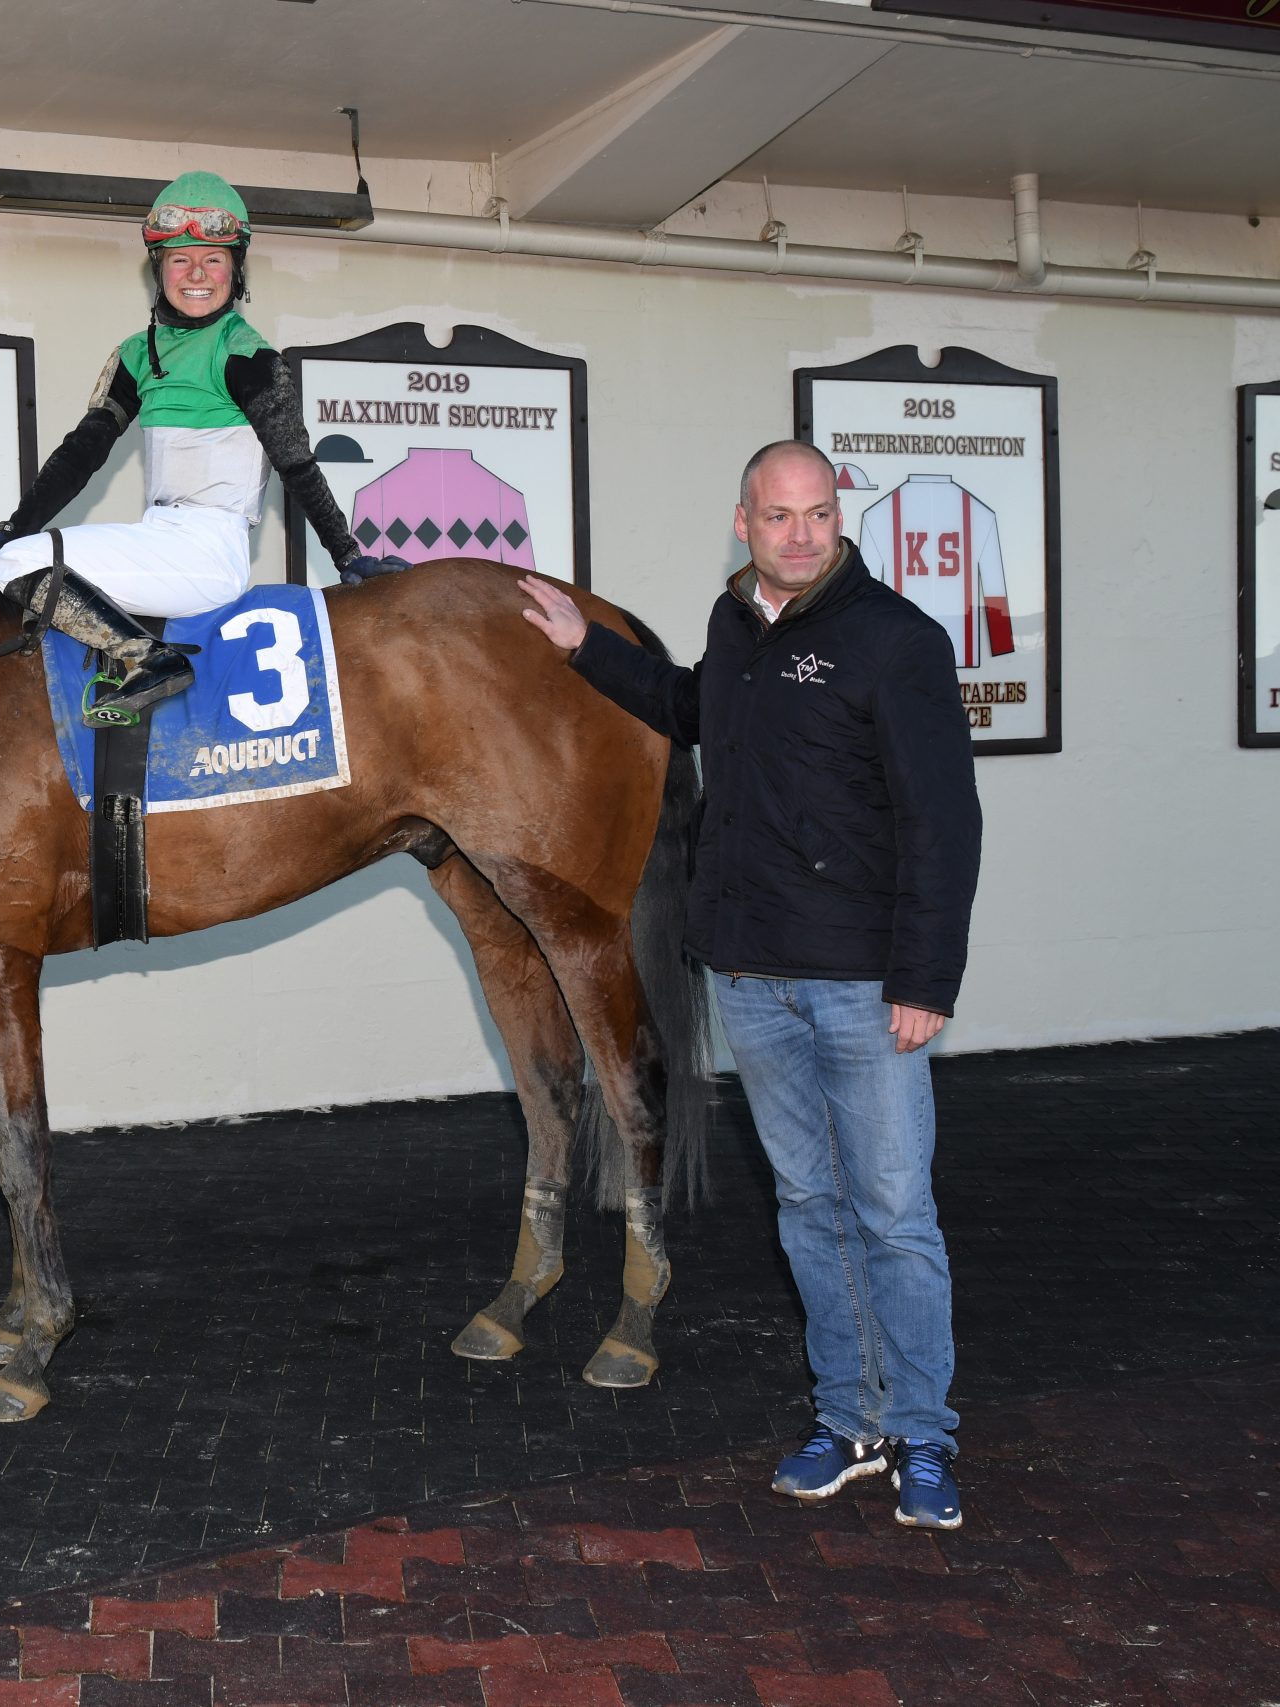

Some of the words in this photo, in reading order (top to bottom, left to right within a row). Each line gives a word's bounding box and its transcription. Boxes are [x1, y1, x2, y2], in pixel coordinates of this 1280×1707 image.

[407, 371, 470, 393] 2019
[317, 399, 440, 426] MAXIMUM
[448, 404, 558, 430] SECURITY
[903, 398, 956, 419] 2018
[831, 432, 1025, 457] PATTERNRECOGNITION
[220, 608, 310, 732] 3
[959, 681, 1027, 705] TABLES
[965, 706, 992, 729] CE
[189, 729, 319, 777] AQUEDUCT
